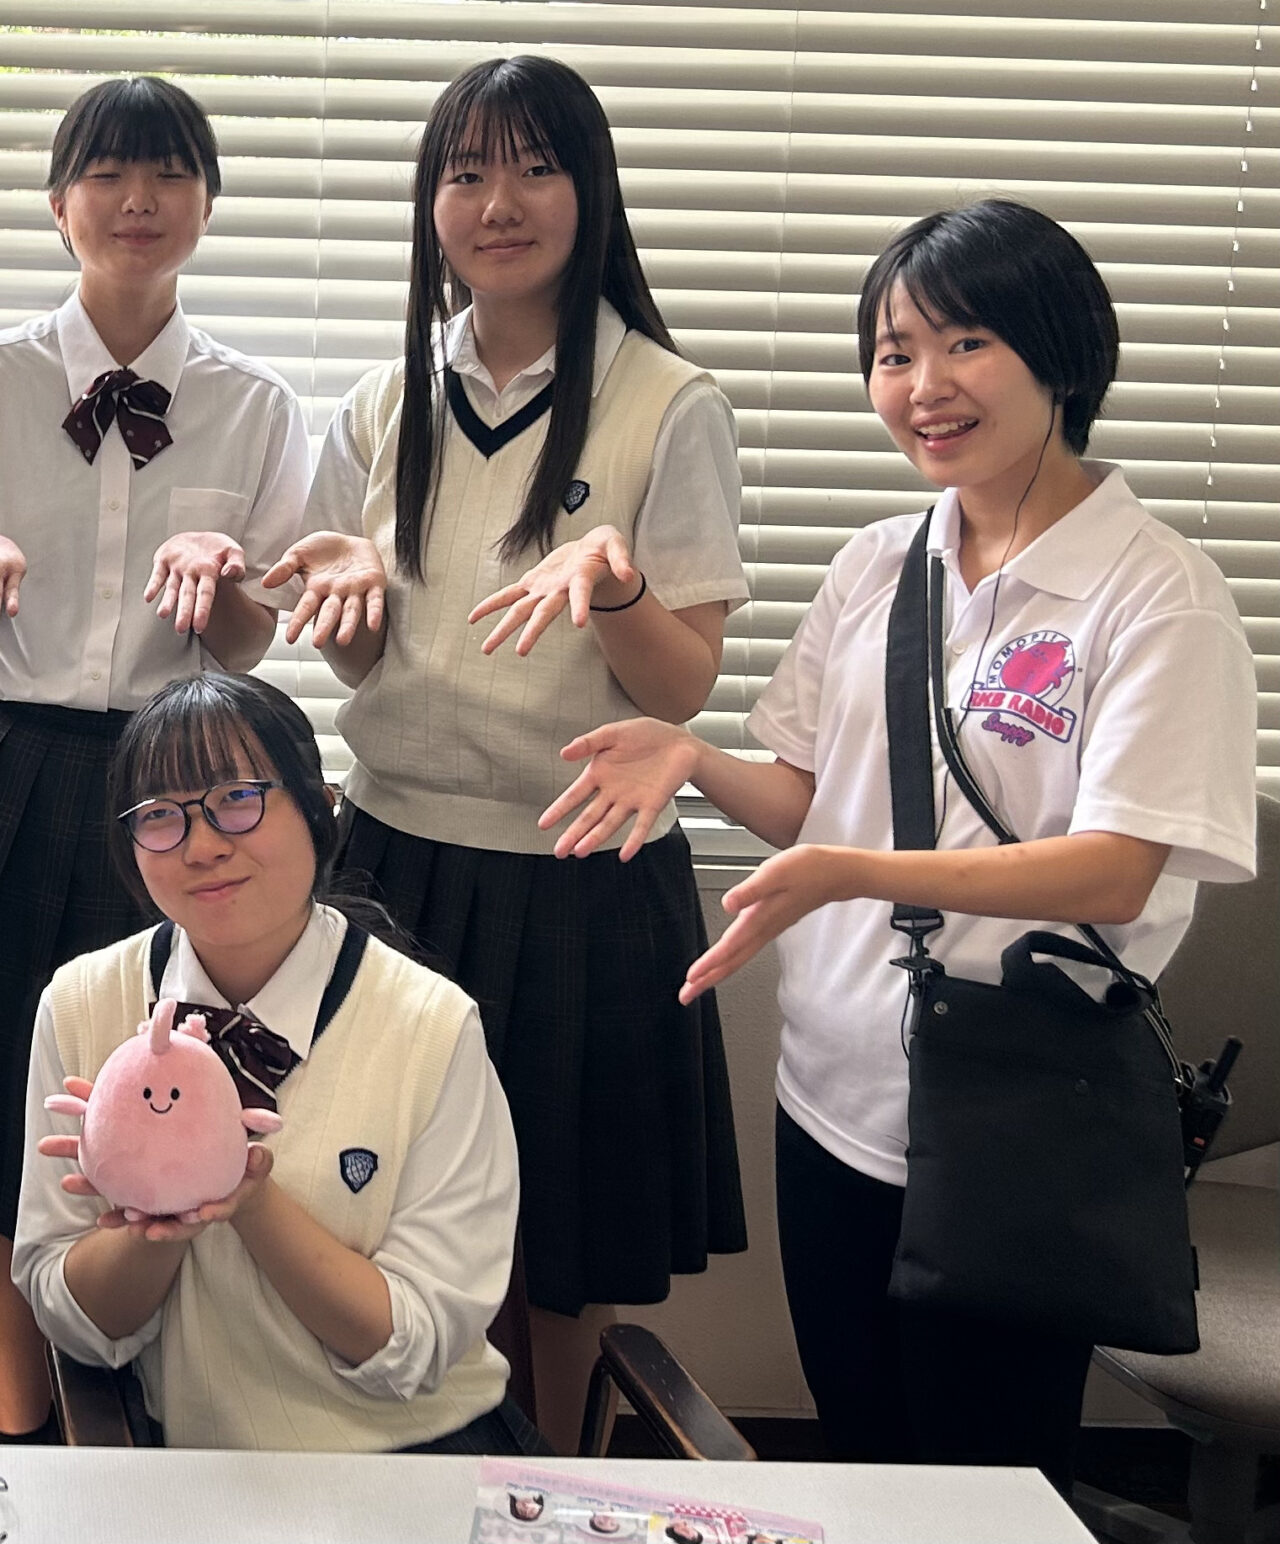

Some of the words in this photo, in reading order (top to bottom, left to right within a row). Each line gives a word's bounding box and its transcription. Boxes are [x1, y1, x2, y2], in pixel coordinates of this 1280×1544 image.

[971, 692, 1006, 708] RKB
[1007, 694, 1066, 736] RADIO
[981, 712, 1035, 747] Snappy
